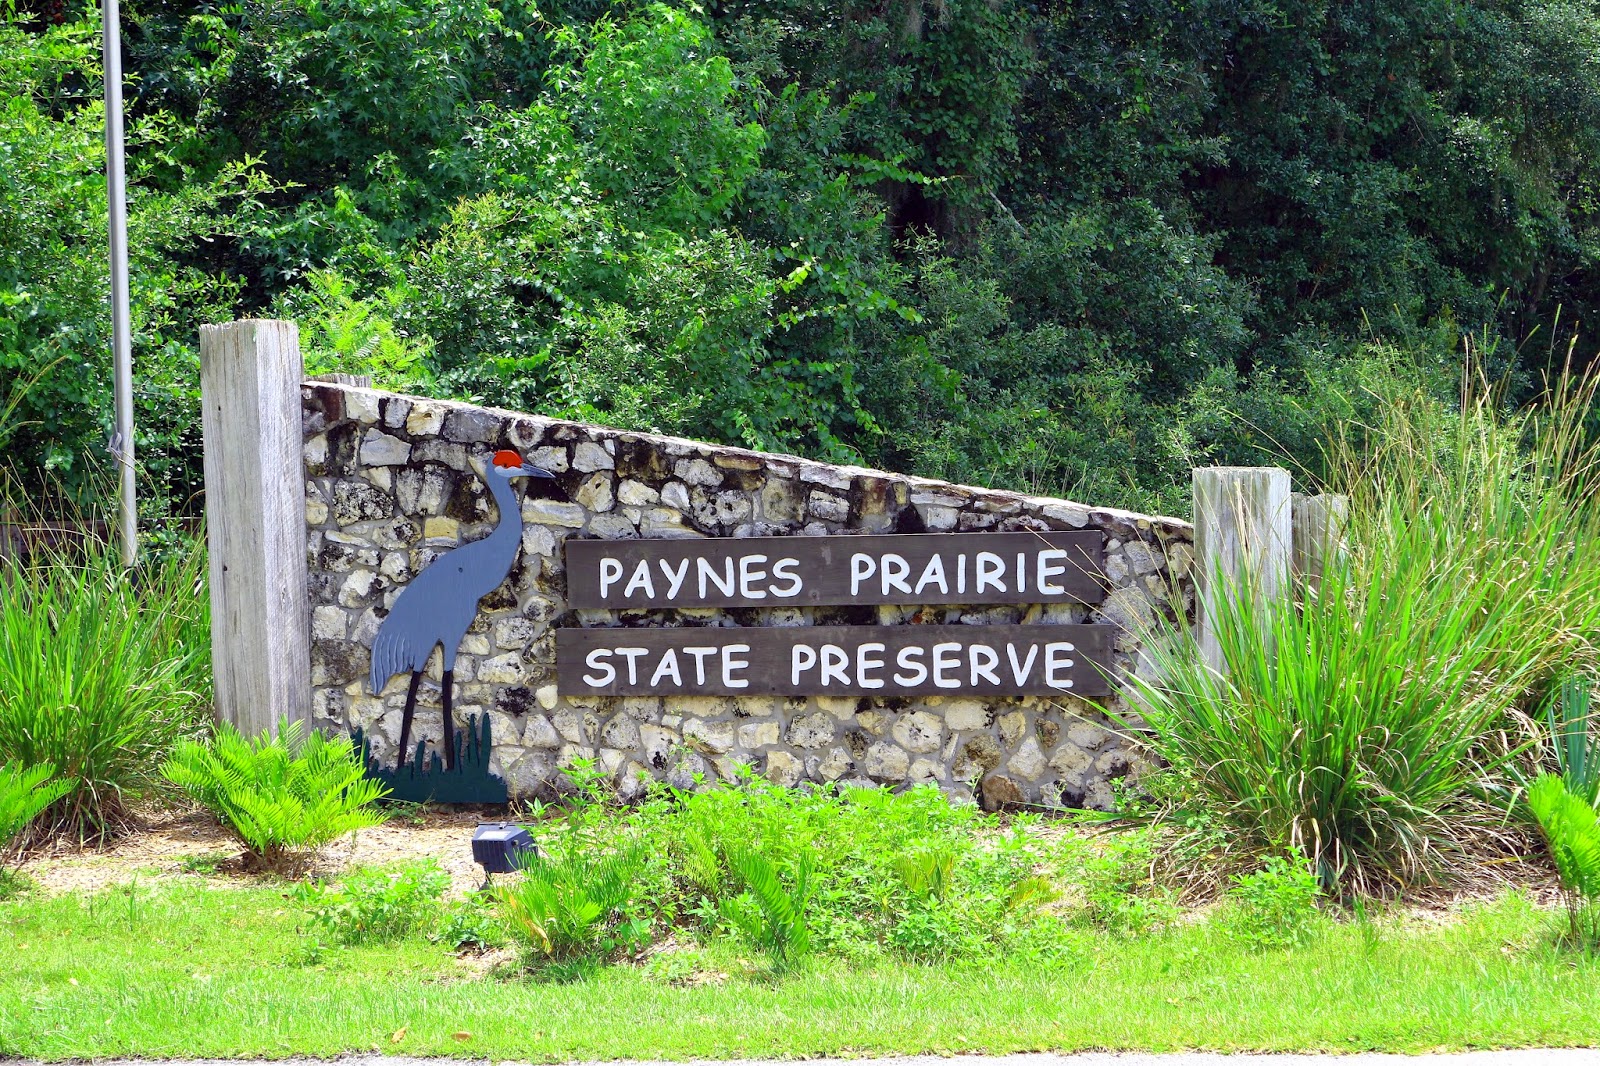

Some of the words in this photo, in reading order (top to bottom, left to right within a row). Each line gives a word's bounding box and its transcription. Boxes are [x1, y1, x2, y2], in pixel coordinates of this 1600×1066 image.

[599, 554, 803, 600] PAYNES
[850, 548, 1069, 596] PRAIRIE
[582, 644, 750, 688] STATE
[791, 641, 1075, 689] PRESERVE
